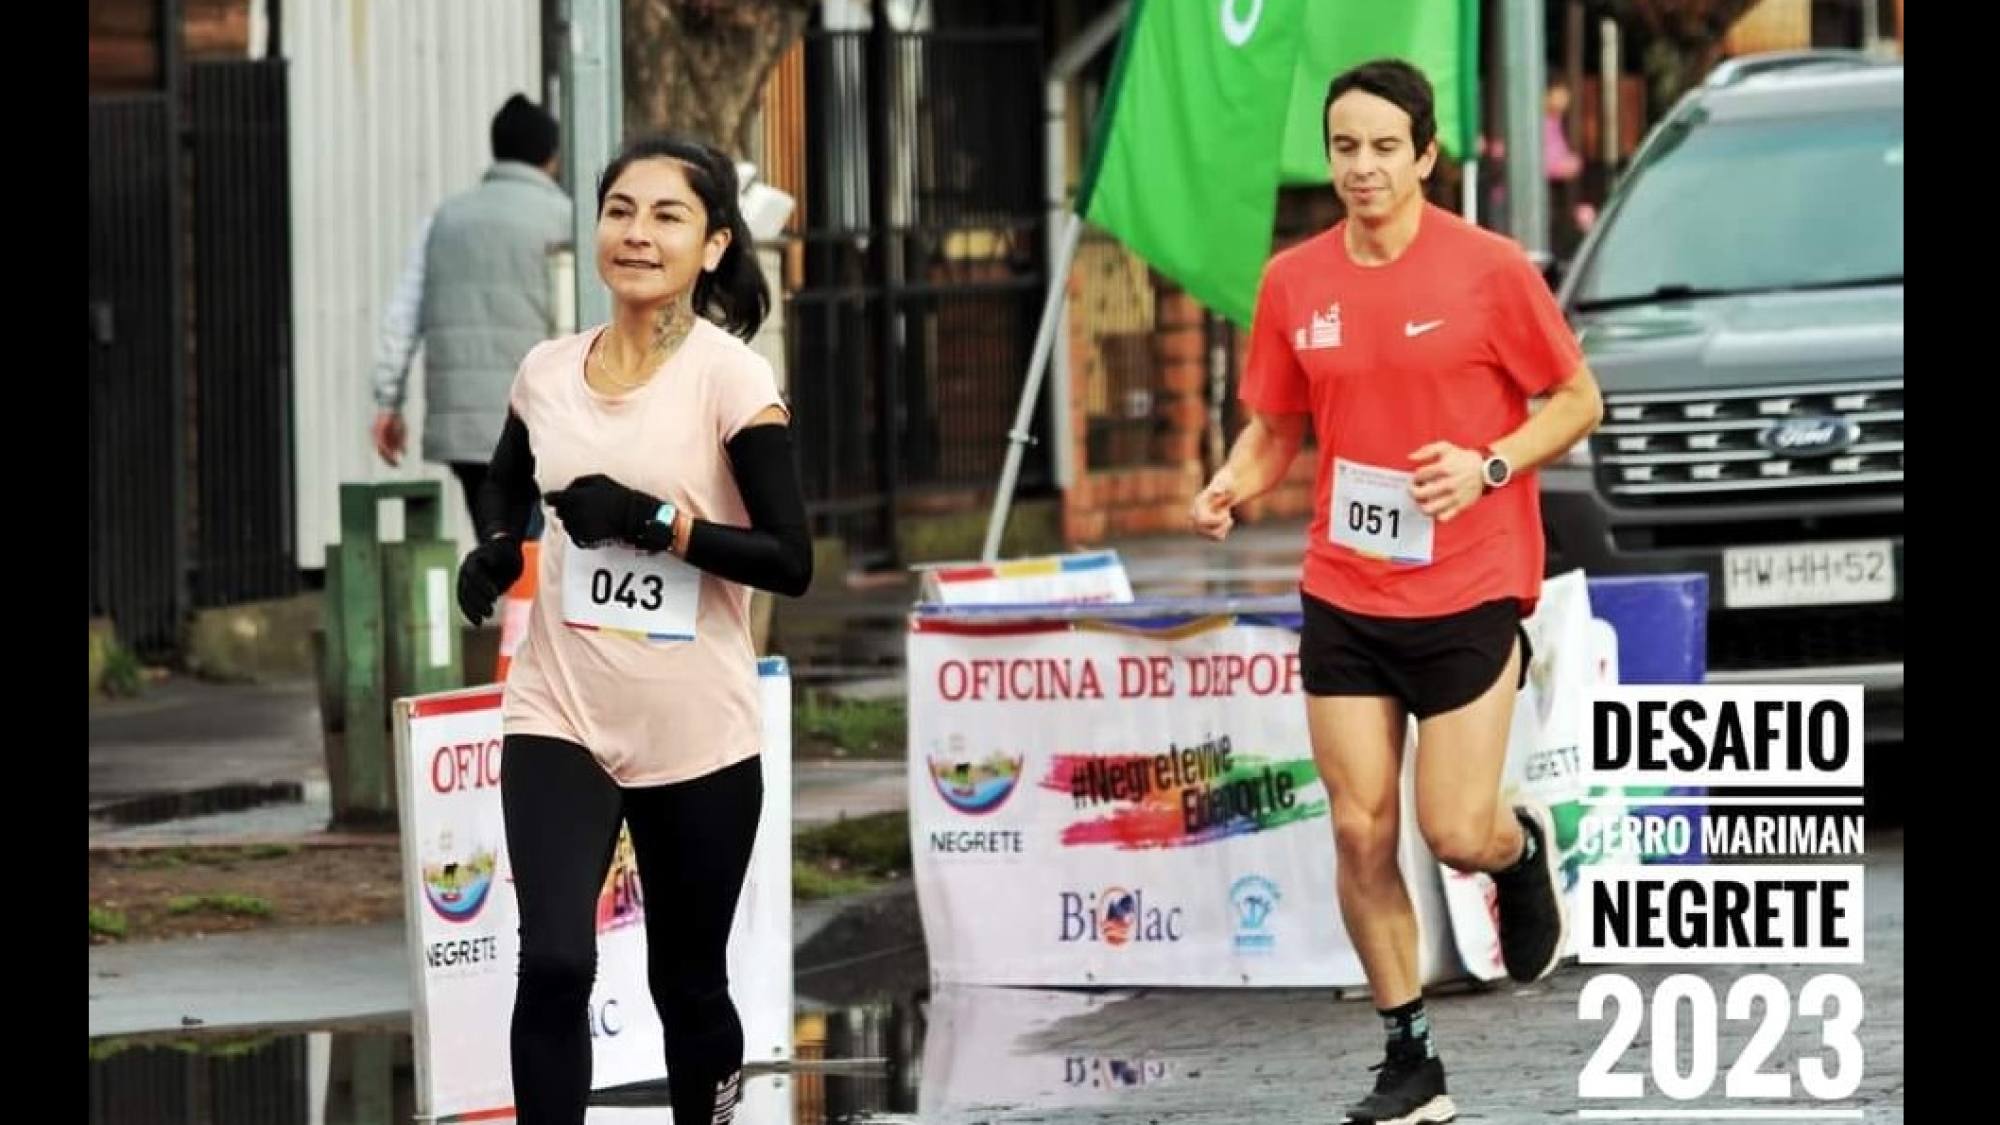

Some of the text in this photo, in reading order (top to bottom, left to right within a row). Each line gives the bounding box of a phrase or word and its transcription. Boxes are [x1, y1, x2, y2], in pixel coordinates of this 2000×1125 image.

[1349, 501, 1400, 539] 051
[592, 568, 664, 611] 043
[938, 657, 1104, 701] OFICINA
[1119, 655, 1174, 699] DE
[930, 832, 1024, 853] NEGRETE
